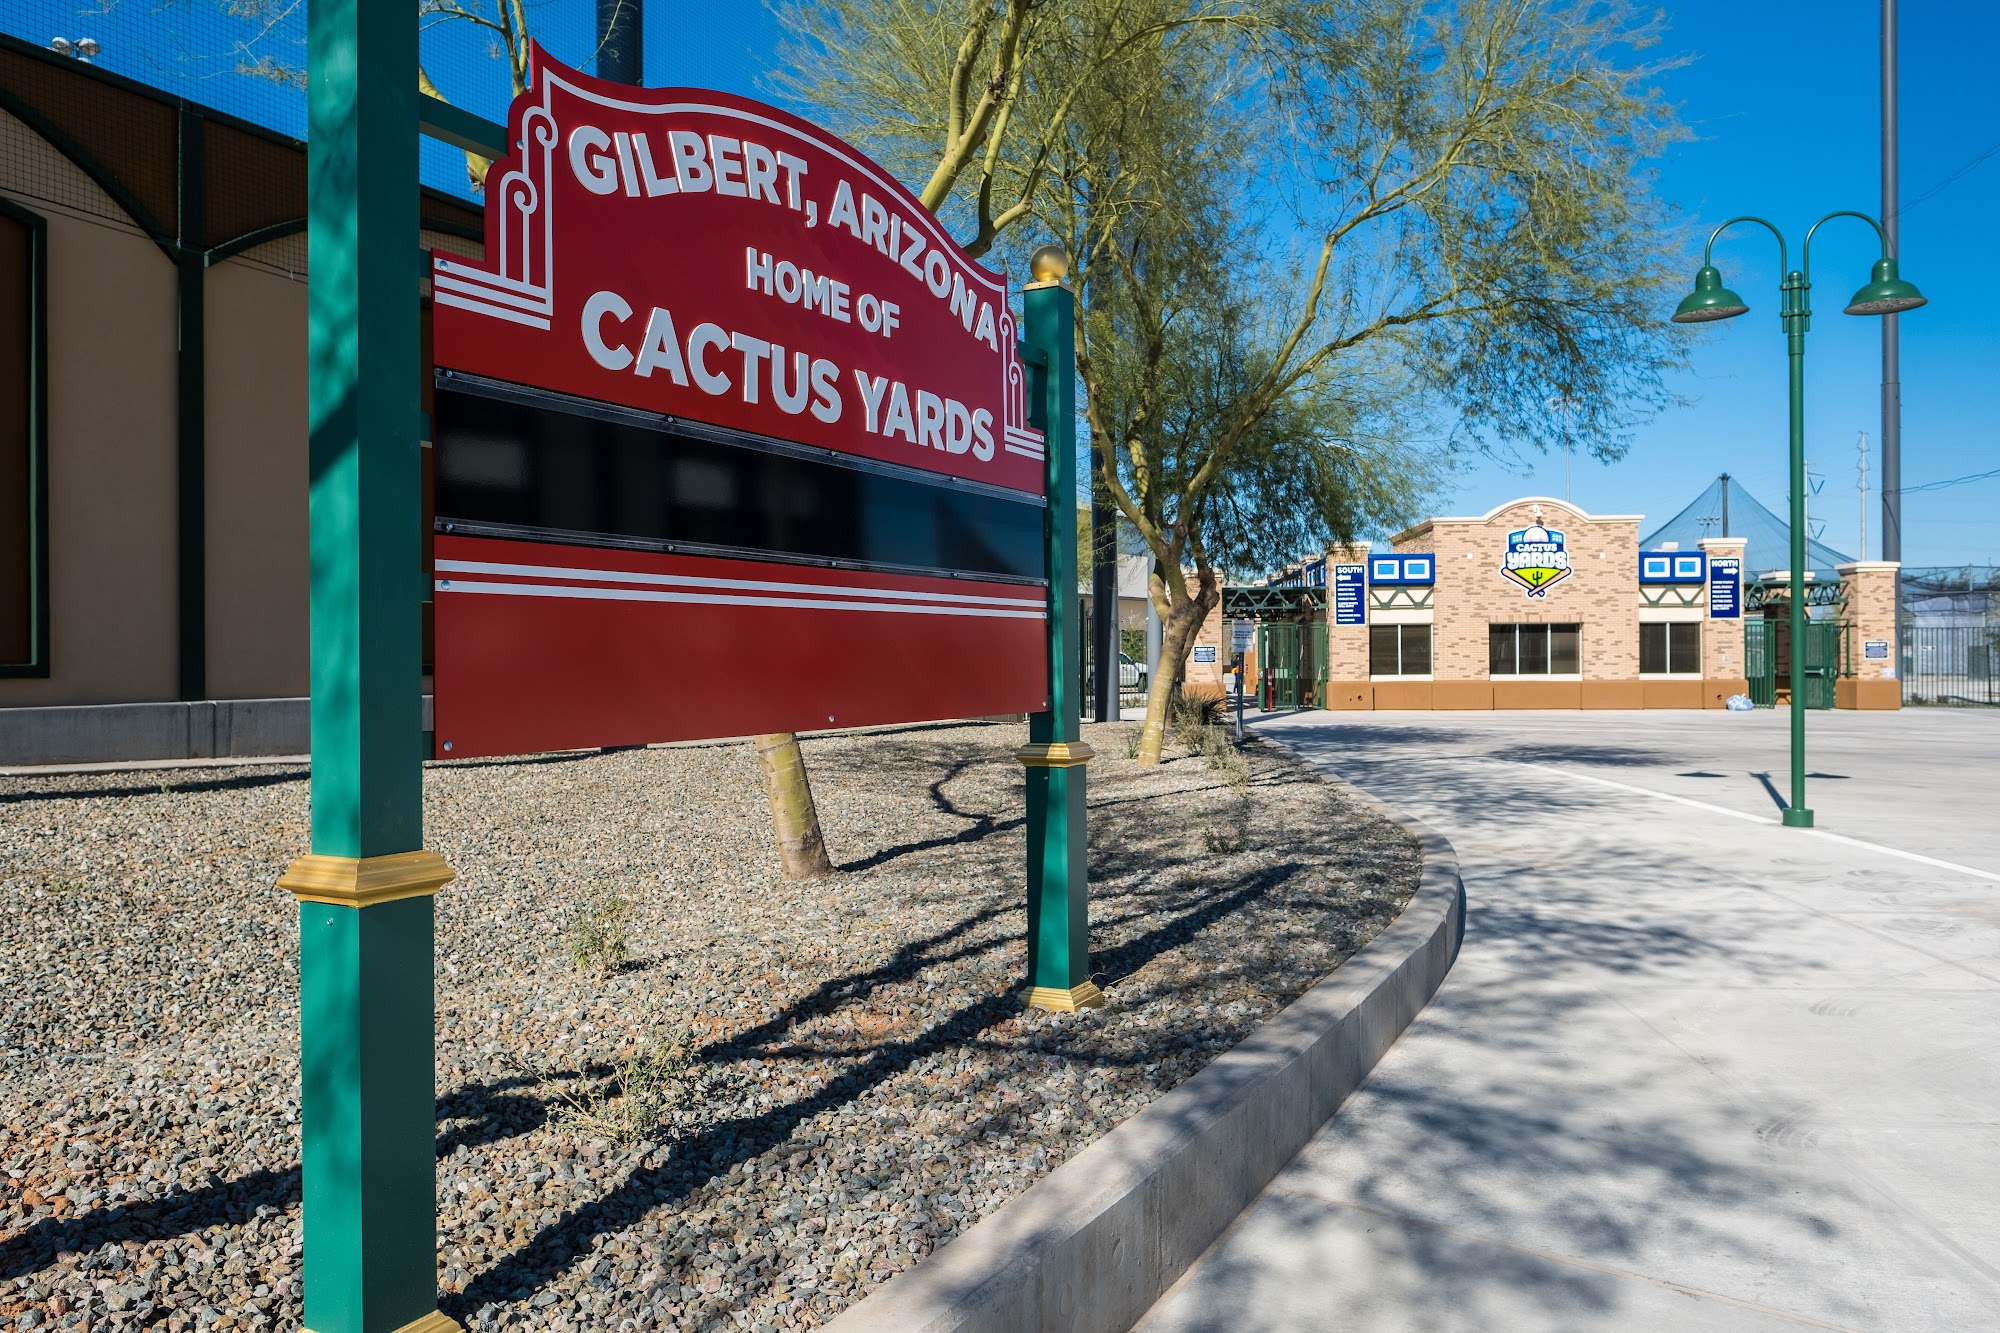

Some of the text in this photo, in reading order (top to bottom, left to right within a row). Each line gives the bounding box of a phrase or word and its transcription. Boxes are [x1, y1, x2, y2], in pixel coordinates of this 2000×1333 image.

[568, 125, 999, 353] GILBERT, ARIZONA
[746, 246, 900, 338] HOME OF
[581, 290, 995, 462] CACTUS YARDS
[1506, 552, 1567, 570] YARDS
[1516, 543, 1557, 552] CACTUS
